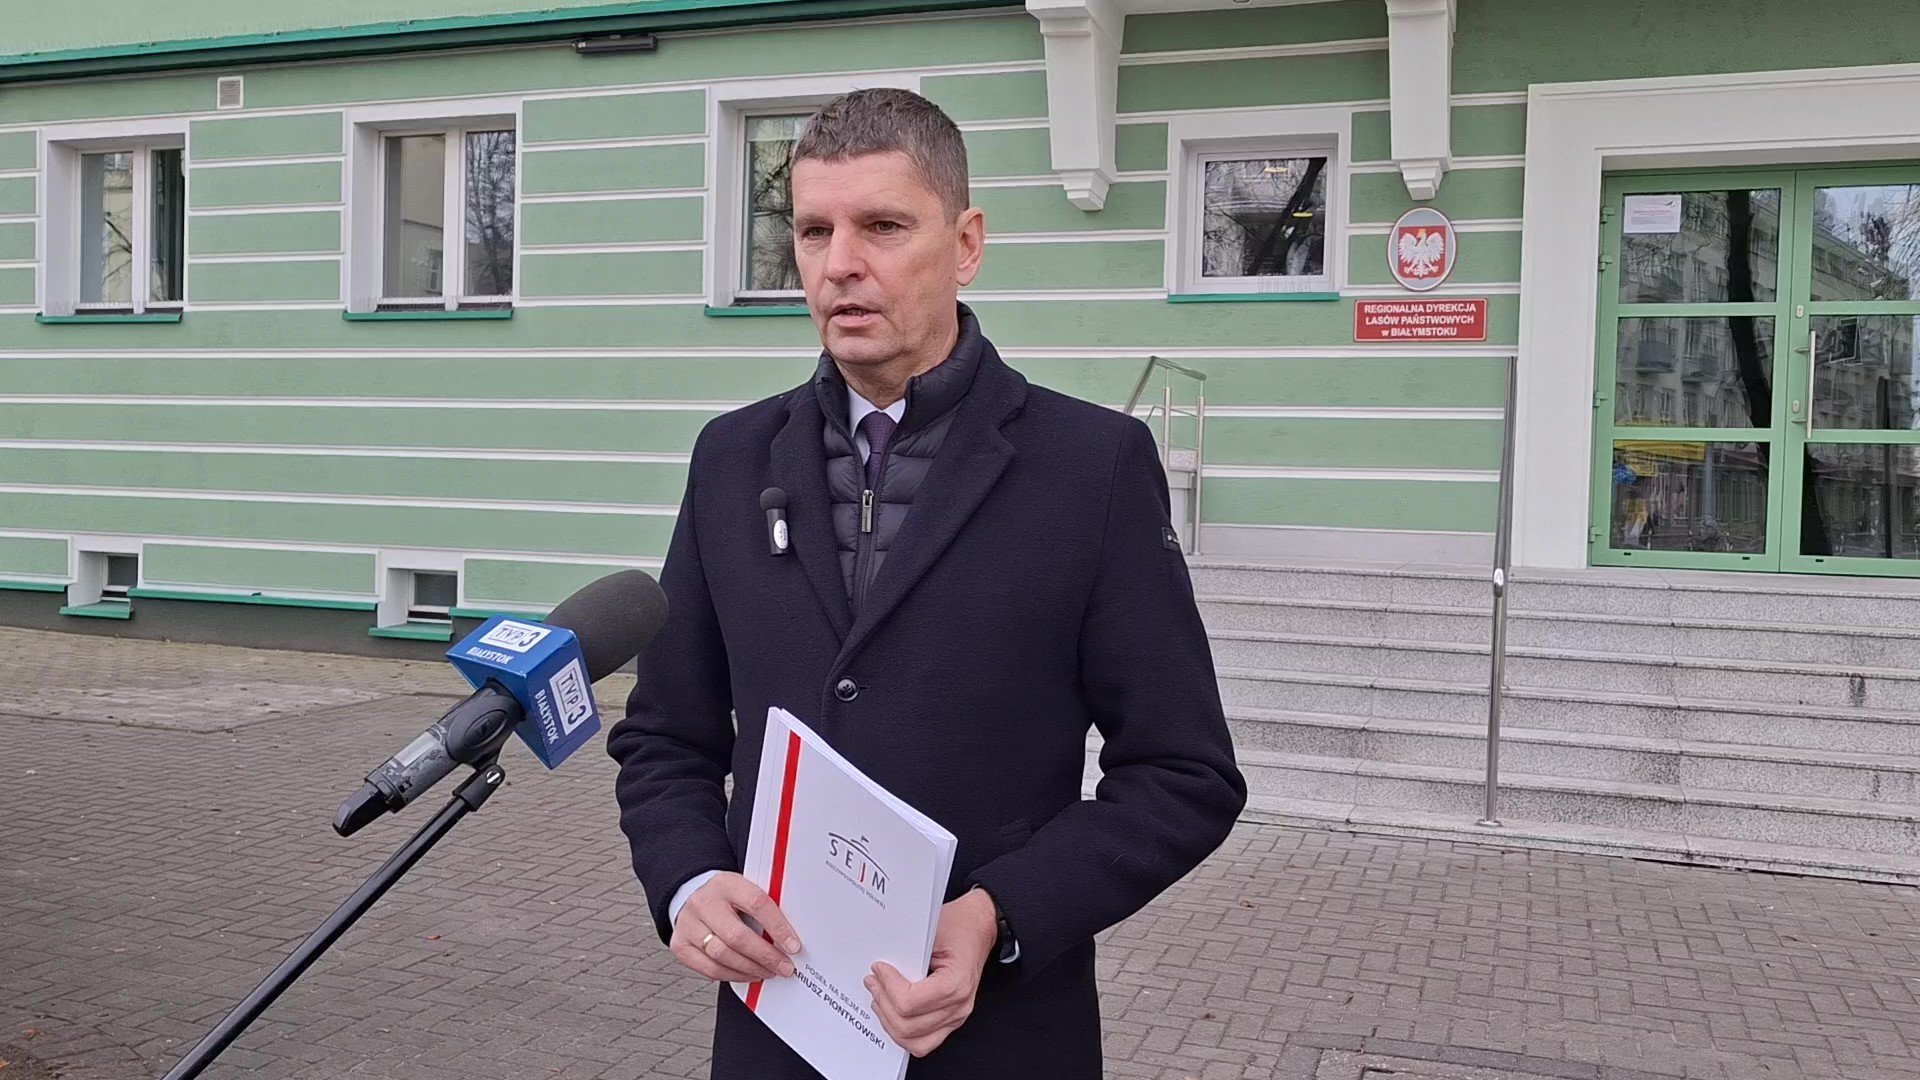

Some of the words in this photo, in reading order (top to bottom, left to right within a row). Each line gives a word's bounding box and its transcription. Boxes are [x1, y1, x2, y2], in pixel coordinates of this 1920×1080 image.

[1364, 304, 1424, 313] REGIONALNA
[1426, 303, 1476, 312] DYREKCJA
[1366, 314, 1399, 325] LASÓW
[1401, 313, 1474, 324] PAŃSTWOWYCH
[1391, 327, 1457, 336] BIAŁYMSTOKU
[466, 646, 514, 664] BIAŁYSTOK
[534, 689, 560, 745] BIAŁYSTOK
[805, 963, 828, 987] POSEŁ
[829, 984, 839, 996] NA
[840, 993, 859, 1013] SEJM
[860, 1009, 871, 1021] RP
[792, 967, 823, 998] ARIUSZ
[823, 993, 886, 1050] PIONTKOWSKI
